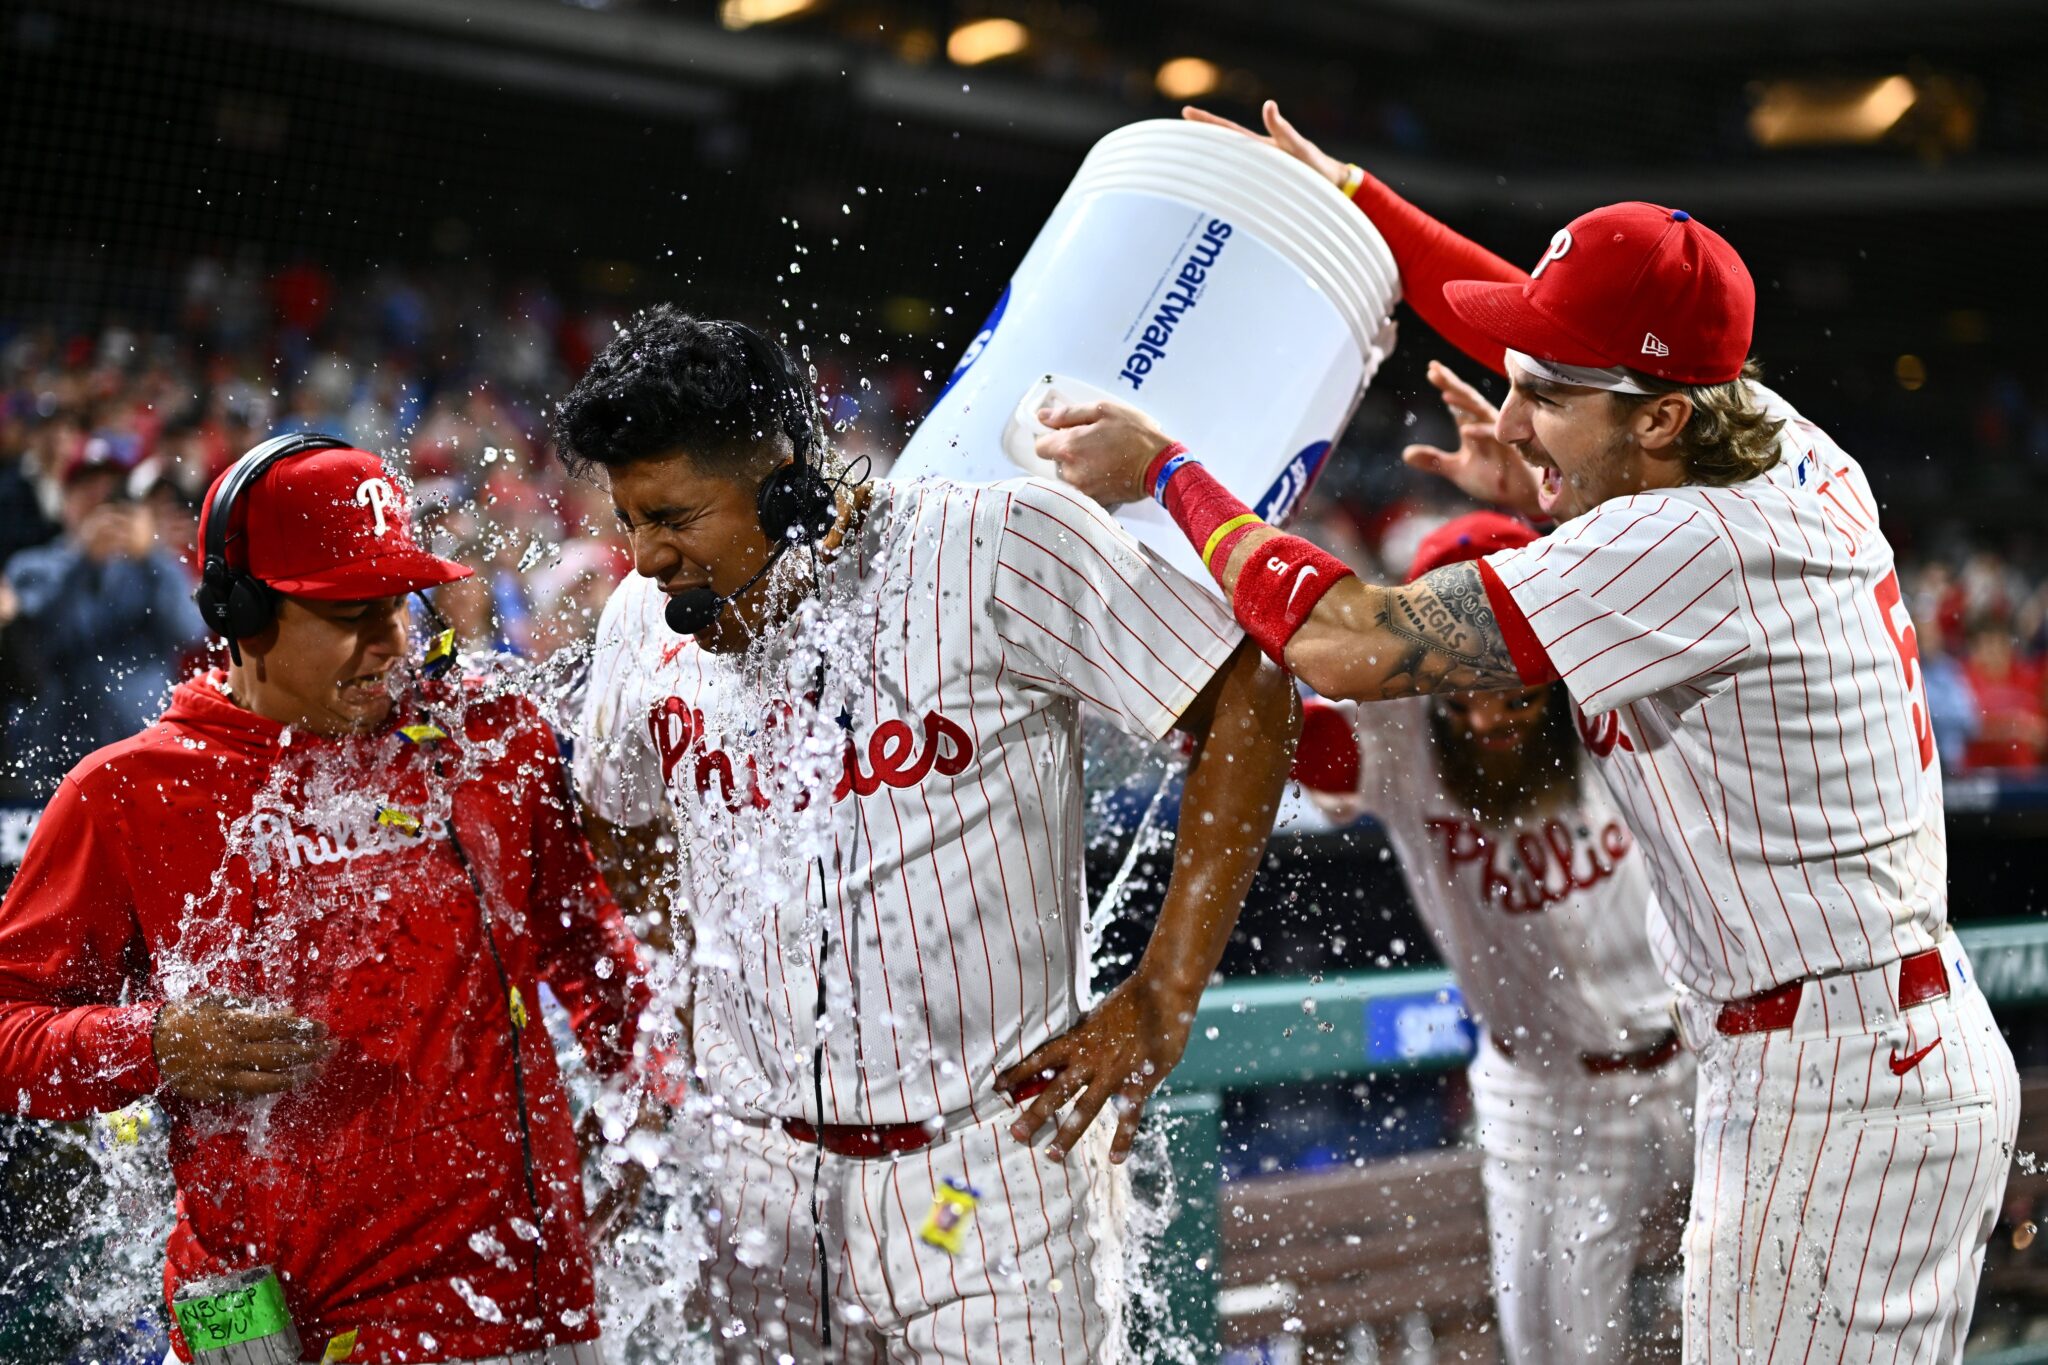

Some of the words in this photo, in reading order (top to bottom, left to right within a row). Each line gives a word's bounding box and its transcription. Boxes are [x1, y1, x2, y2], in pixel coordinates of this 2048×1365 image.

[1531, 228, 1573, 280] P
[1120, 219, 1232, 390] smartwater
[356, 477, 394, 537] P
[1267, 556, 1289, 576] 5
[1396, 593, 1426, 633] NEVADA
[1414, 589, 1467, 650] VEGAS
[1424, 816, 1631, 916] Phillie
[208, 1318, 248, 1339] B/U
